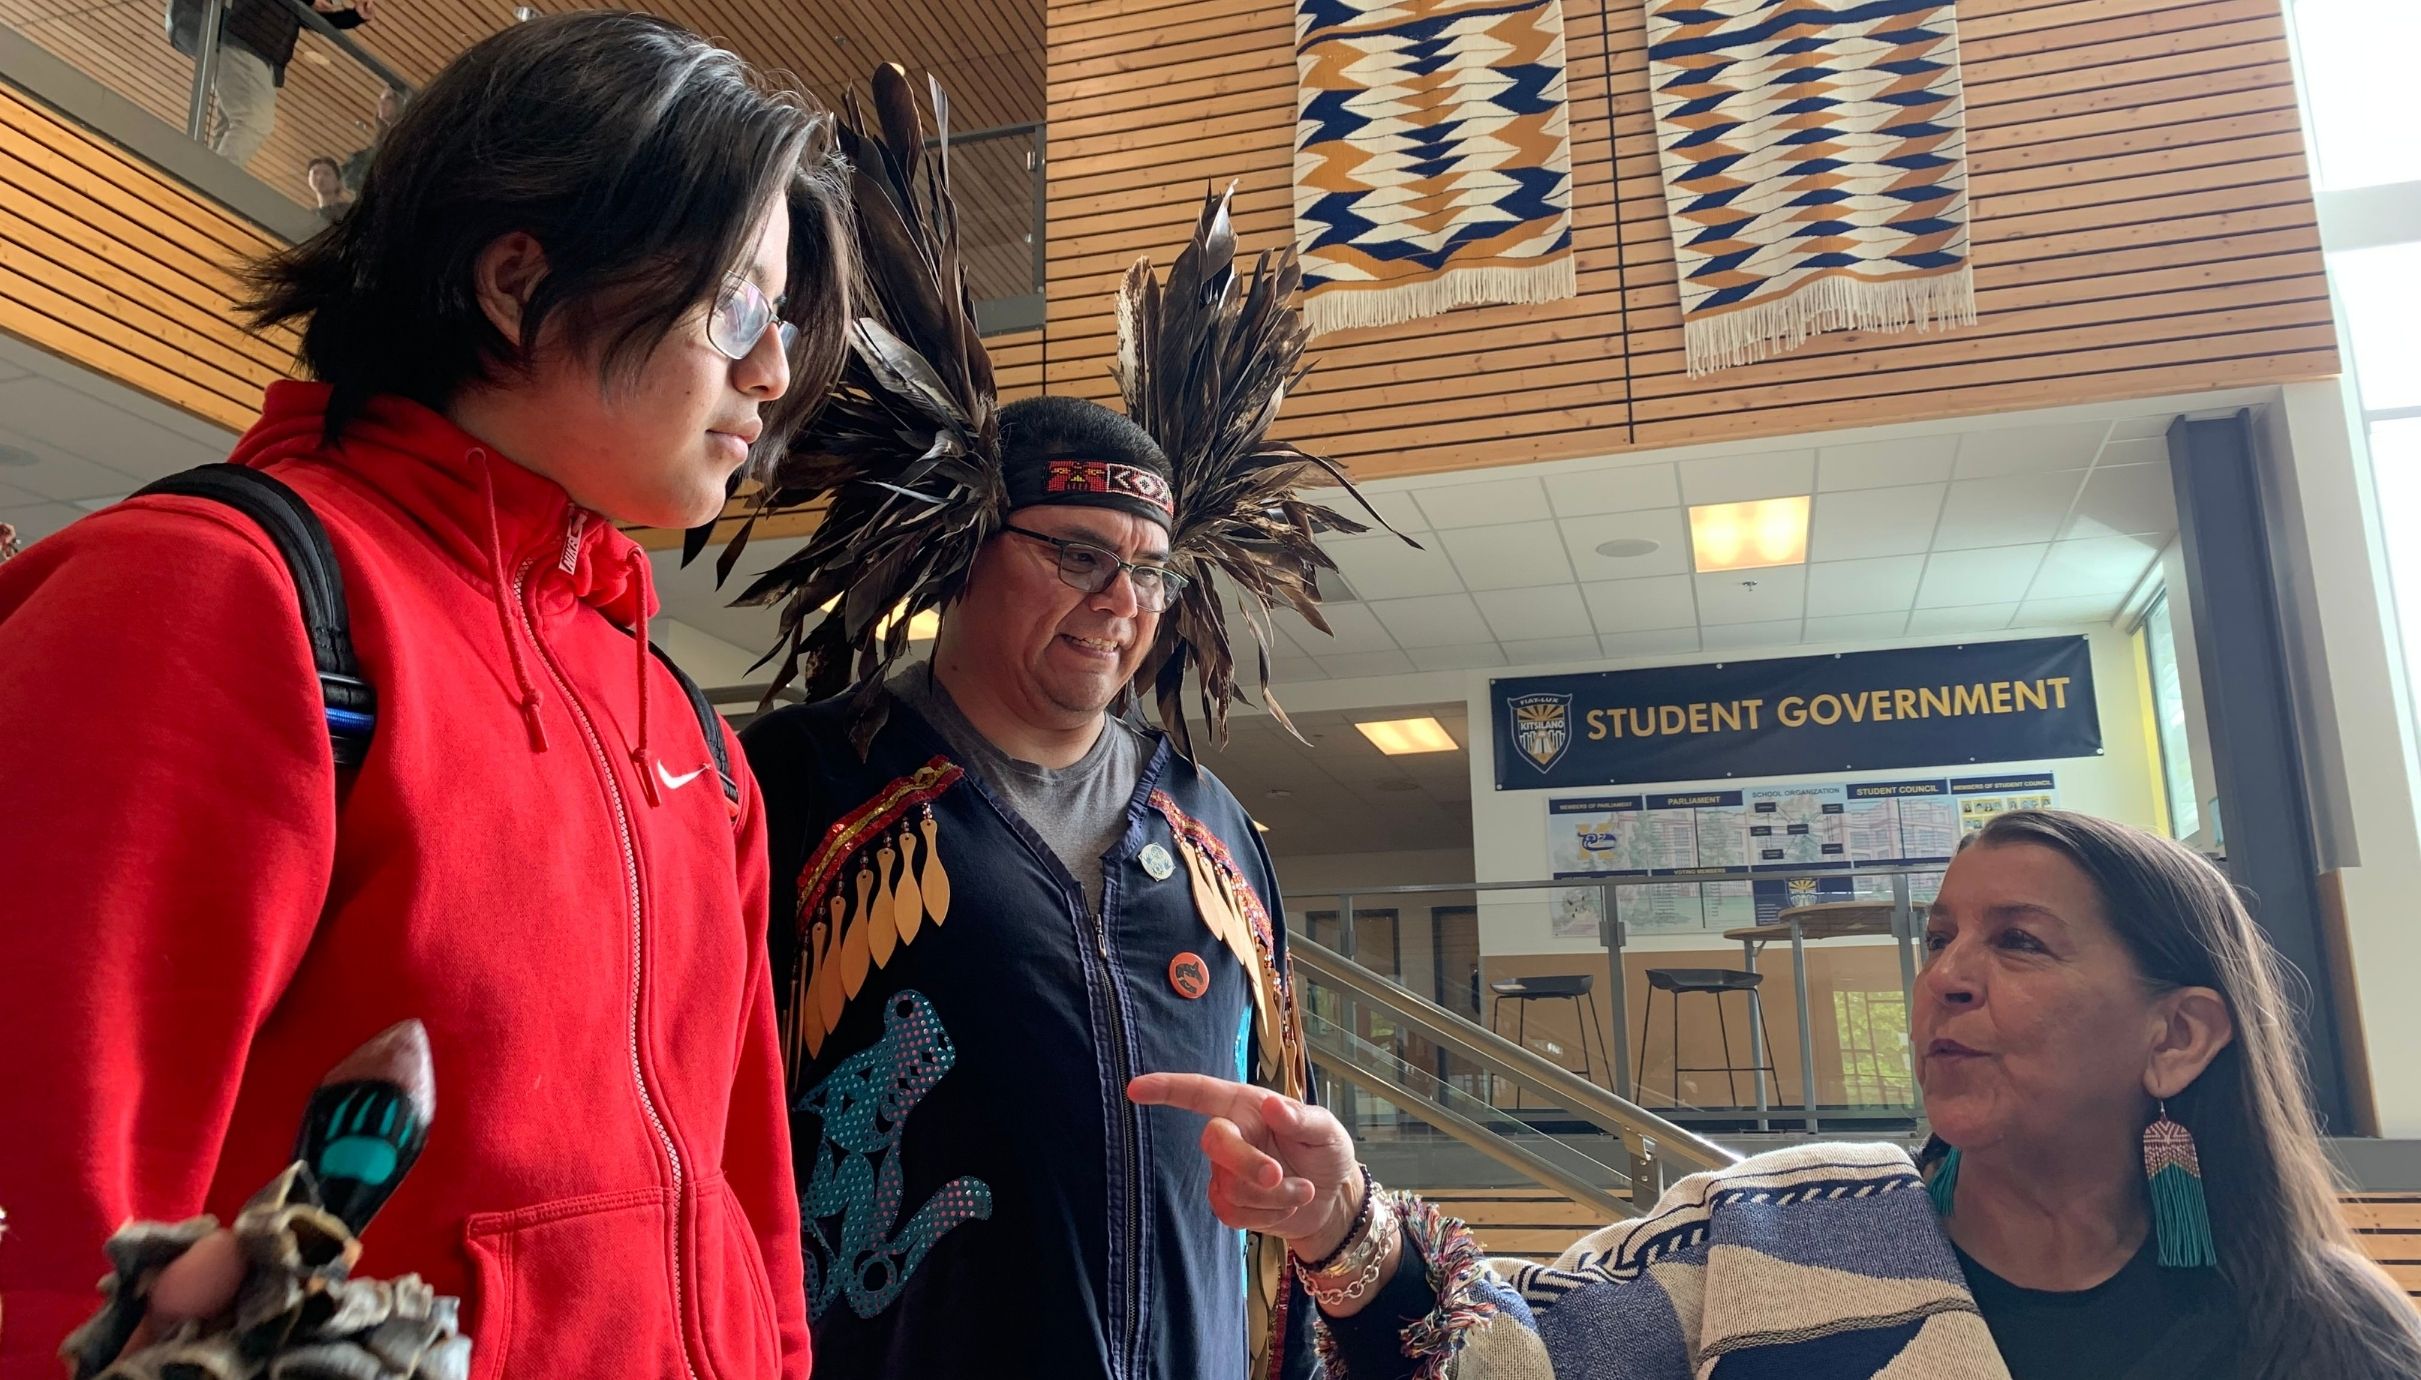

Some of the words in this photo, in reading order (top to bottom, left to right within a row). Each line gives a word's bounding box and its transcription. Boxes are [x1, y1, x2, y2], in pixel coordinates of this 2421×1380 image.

[1586, 698, 1763, 741] STUDENT
[1777, 677, 2070, 728] GOVERNMENT
[1520, 720, 1565, 731] KITSILANO
[1994, 781, 2023, 789] STUDENT
[2024, 779, 2053, 787] COUNCIL
[1784, 787, 1840, 797] ORGANIZATION
[1856, 787, 1897, 796] STUDENT
[1899, 785, 1938, 794] COUNCIL
[1597, 801, 1632, 809] PARLIAMENT
[1667, 796, 1721, 806] PARLIAMENT
